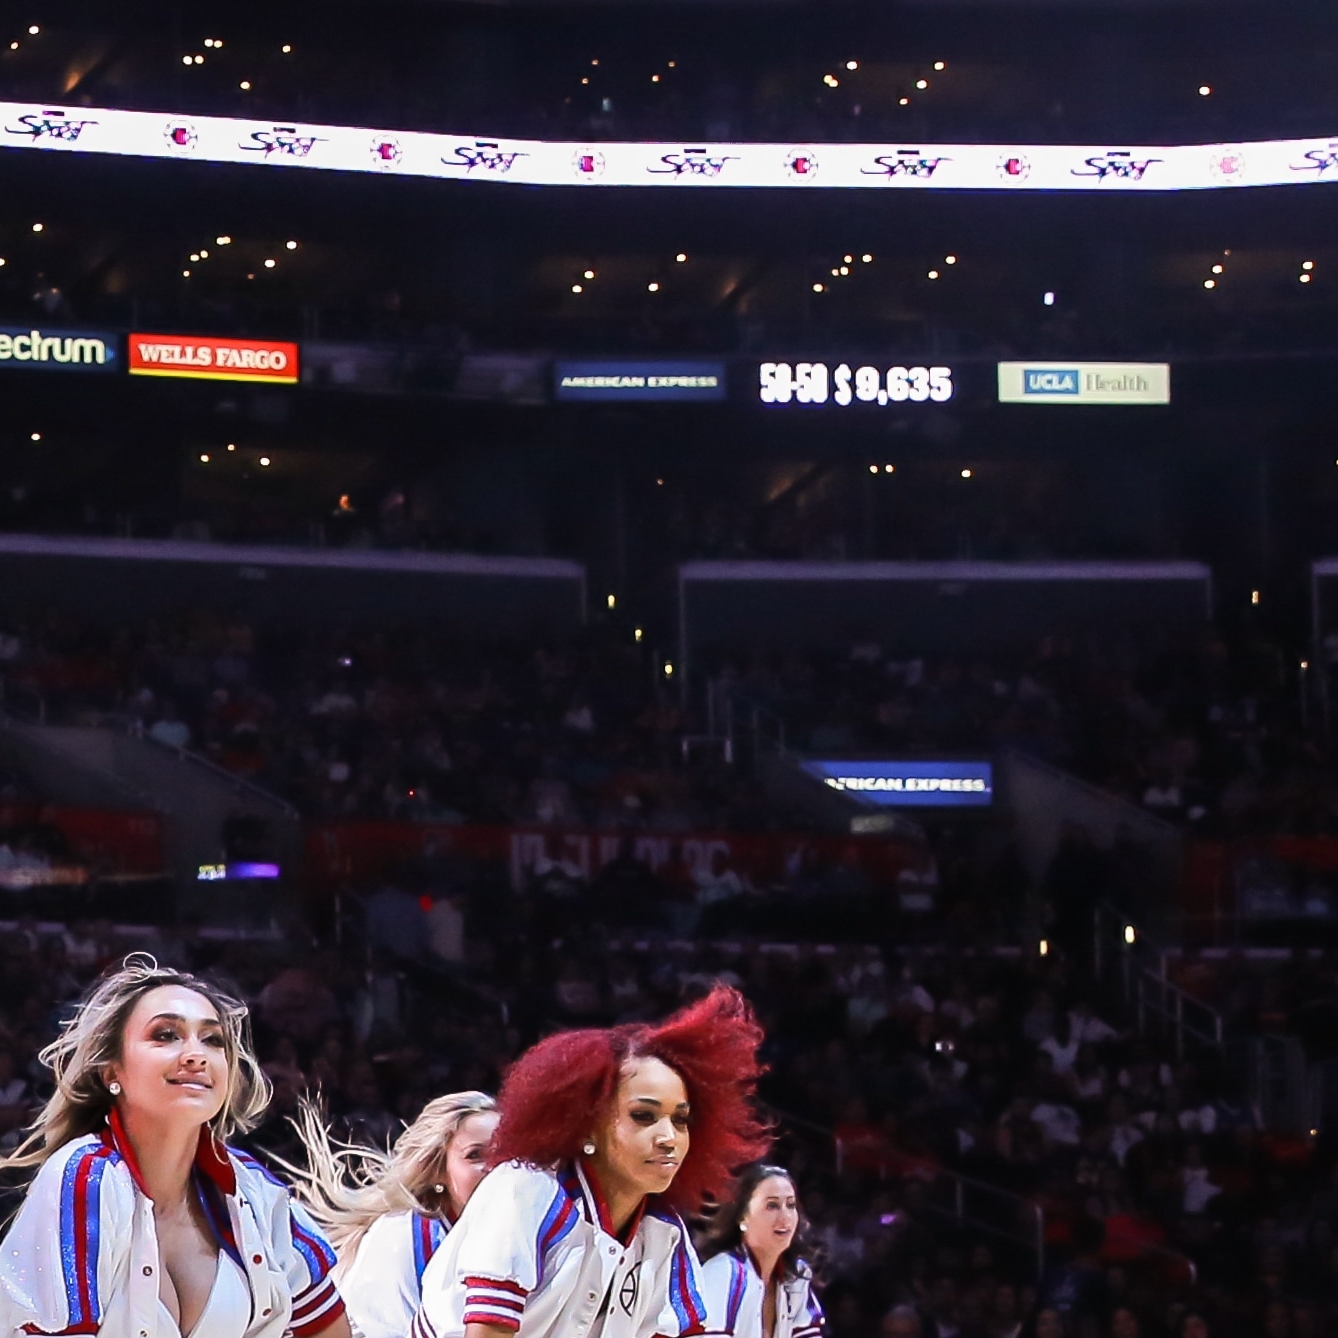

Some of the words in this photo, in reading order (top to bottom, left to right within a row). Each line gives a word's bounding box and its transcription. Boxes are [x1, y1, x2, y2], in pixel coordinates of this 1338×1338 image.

[139, 342, 212, 367] WELLS
[215, 347, 288, 370] FARGO
[561, 376, 645, 388] AMERICAN
[647, 376, 718, 388] EXPRESS
[760, 362, 829, 403] 50-50
[1028, 373, 1074, 392] UCLA
[1086, 373, 1149, 392] Health
[905, 777, 986, 792] EXPRESS
